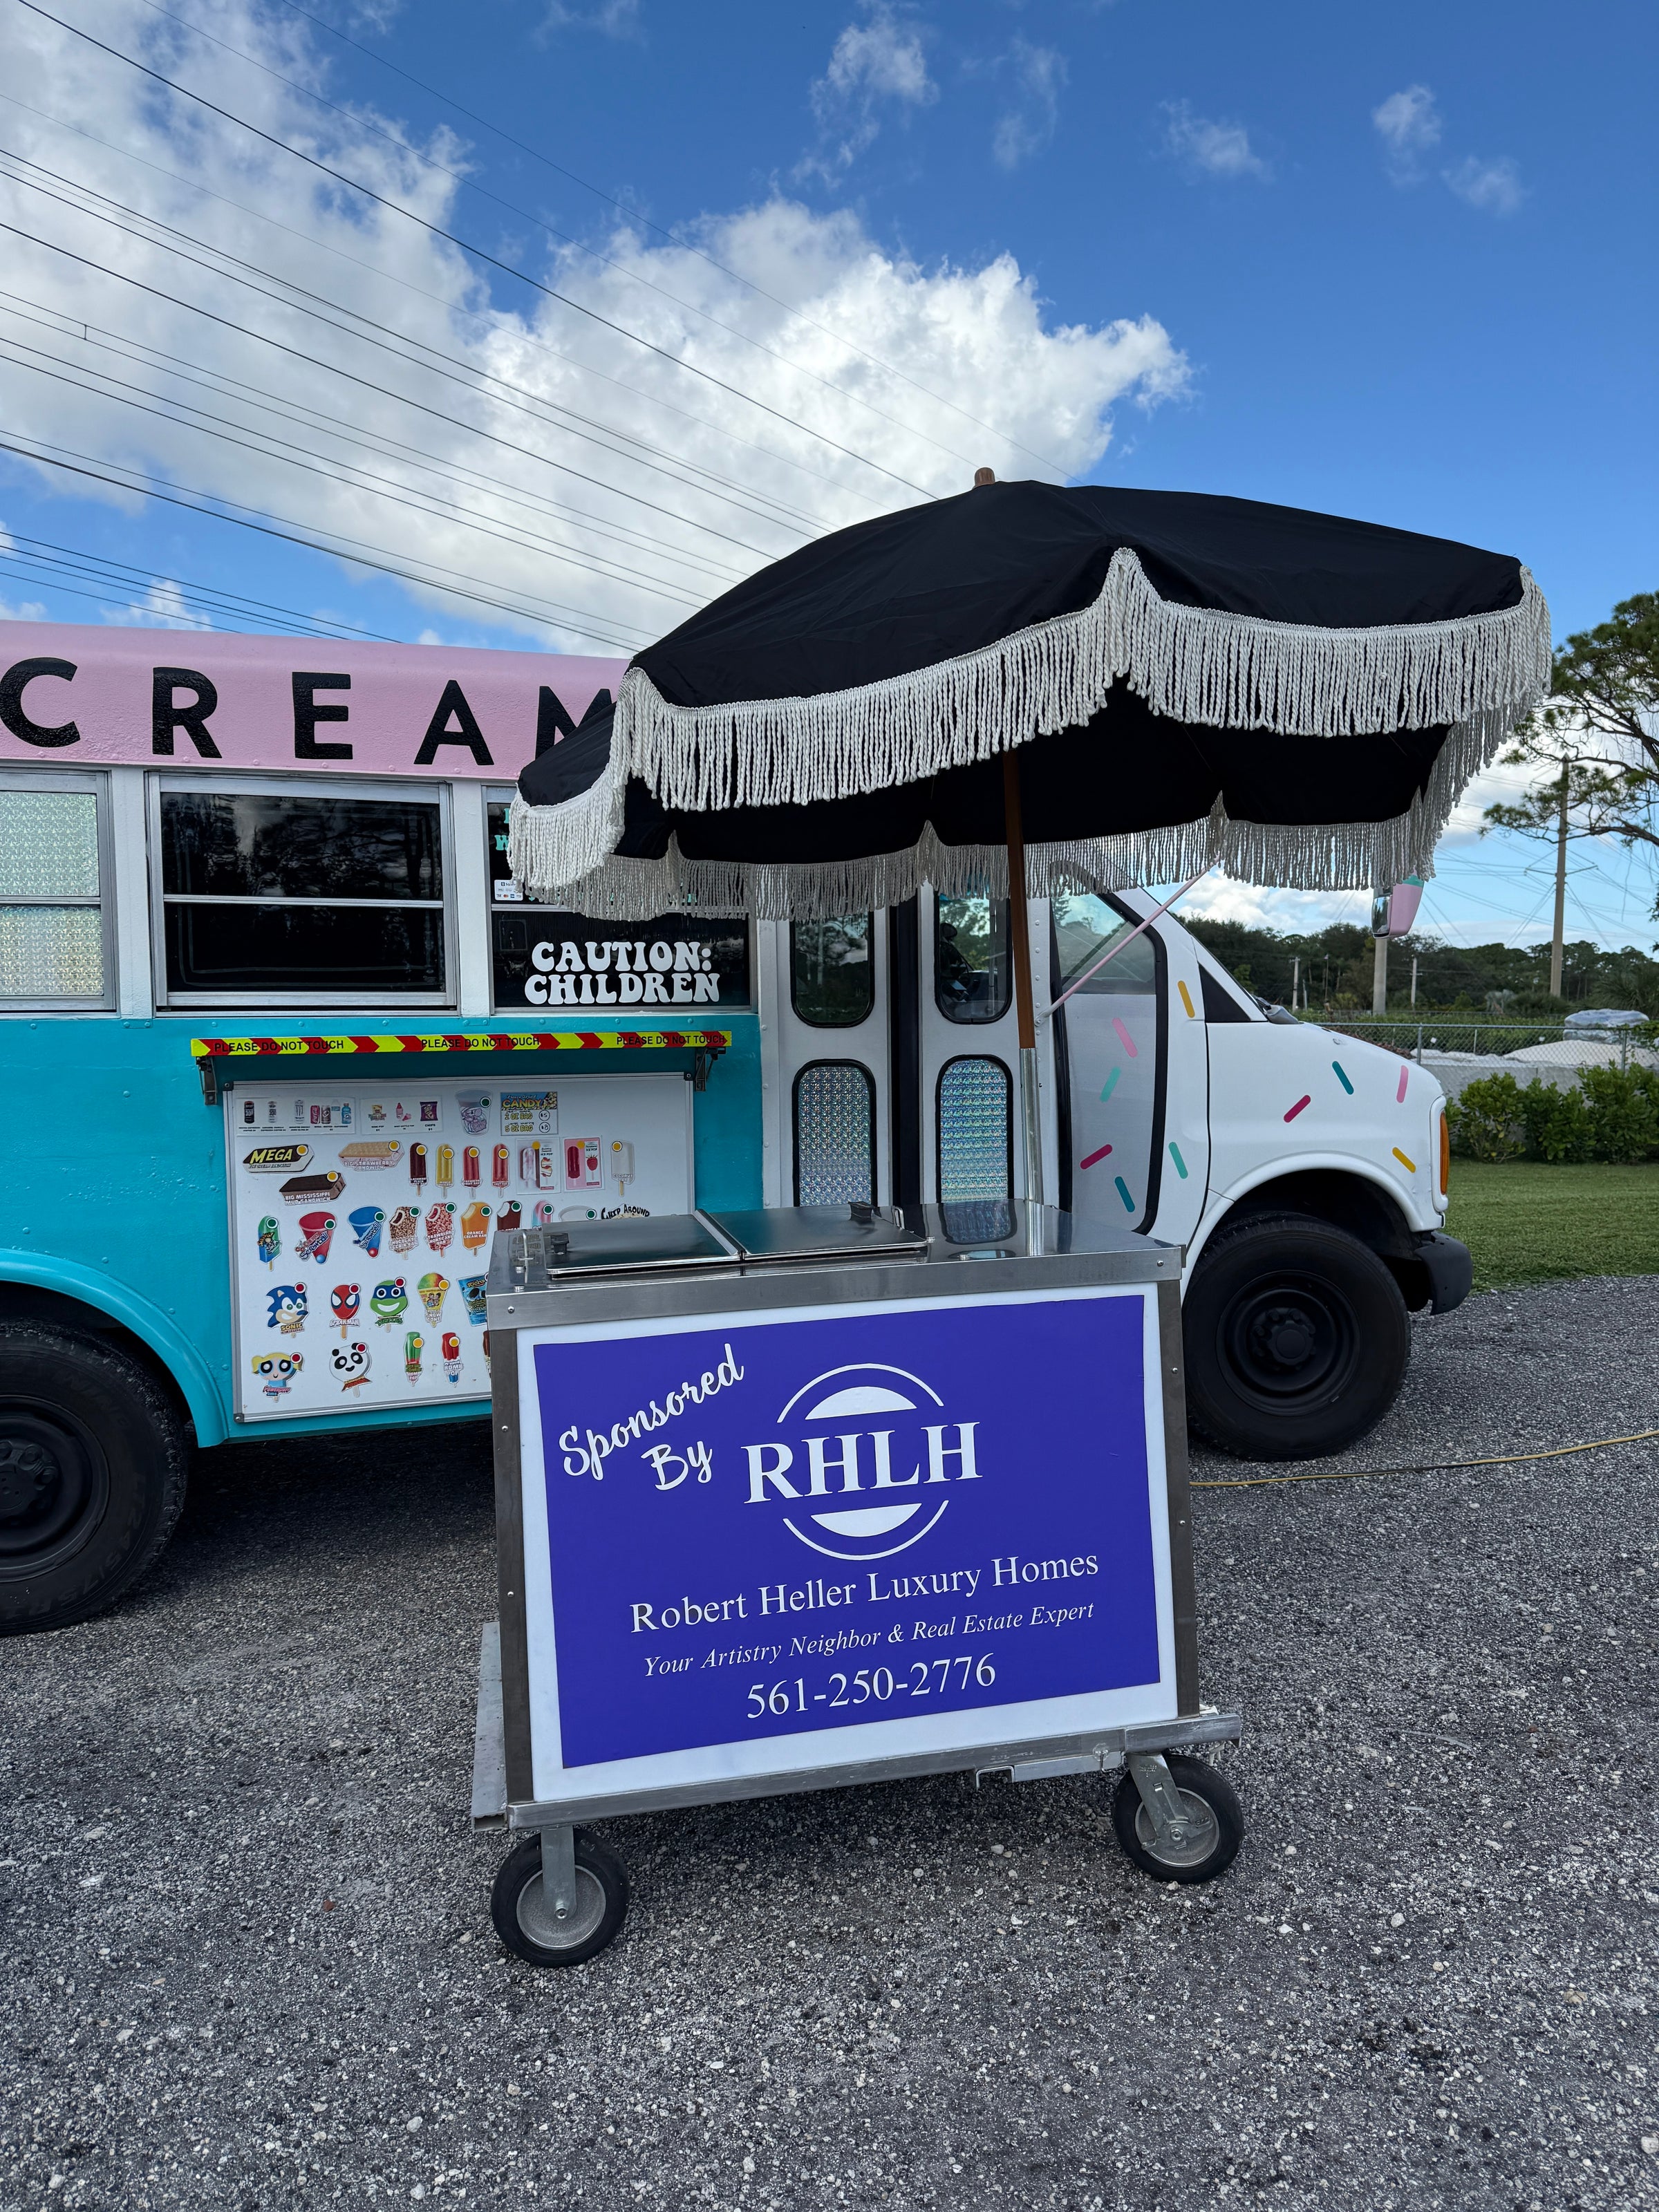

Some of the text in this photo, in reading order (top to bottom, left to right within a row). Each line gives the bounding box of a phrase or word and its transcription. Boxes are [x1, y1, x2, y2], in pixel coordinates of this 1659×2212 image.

[0, 657, 612, 765] CREAM
[532, 941, 711, 972] CAUTION:
[525, 973, 720, 1004] CHILDREN
[214, 1040, 344, 1052] PLEASE DO NOT TOUCH
[421, 1036, 540, 1049] PLEASE DO NOT TOUCH
[617, 1035, 725, 1045] PLEASE DO NOT TOUCH
[502, 1099, 541, 1109] CANDY
[250, 1148, 293, 1165] MEGA
[601, 1204, 650, 1219] CHIP AROUND
[281, 1322, 303, 1331] SONIC
[559, 1343, 744, 1481] Sponsored
[641, 1439, 713, 1490] By
[741, 1421, 983, 1503] RHLH
[630, 1554, 1099, 1633] Robert Heller Luxury Homes
[644, 1602, 1095, 1678] Your Artistry Neighbor & Real Estate Expert
[746, 1653, 997, 1719] 561-250-2776
